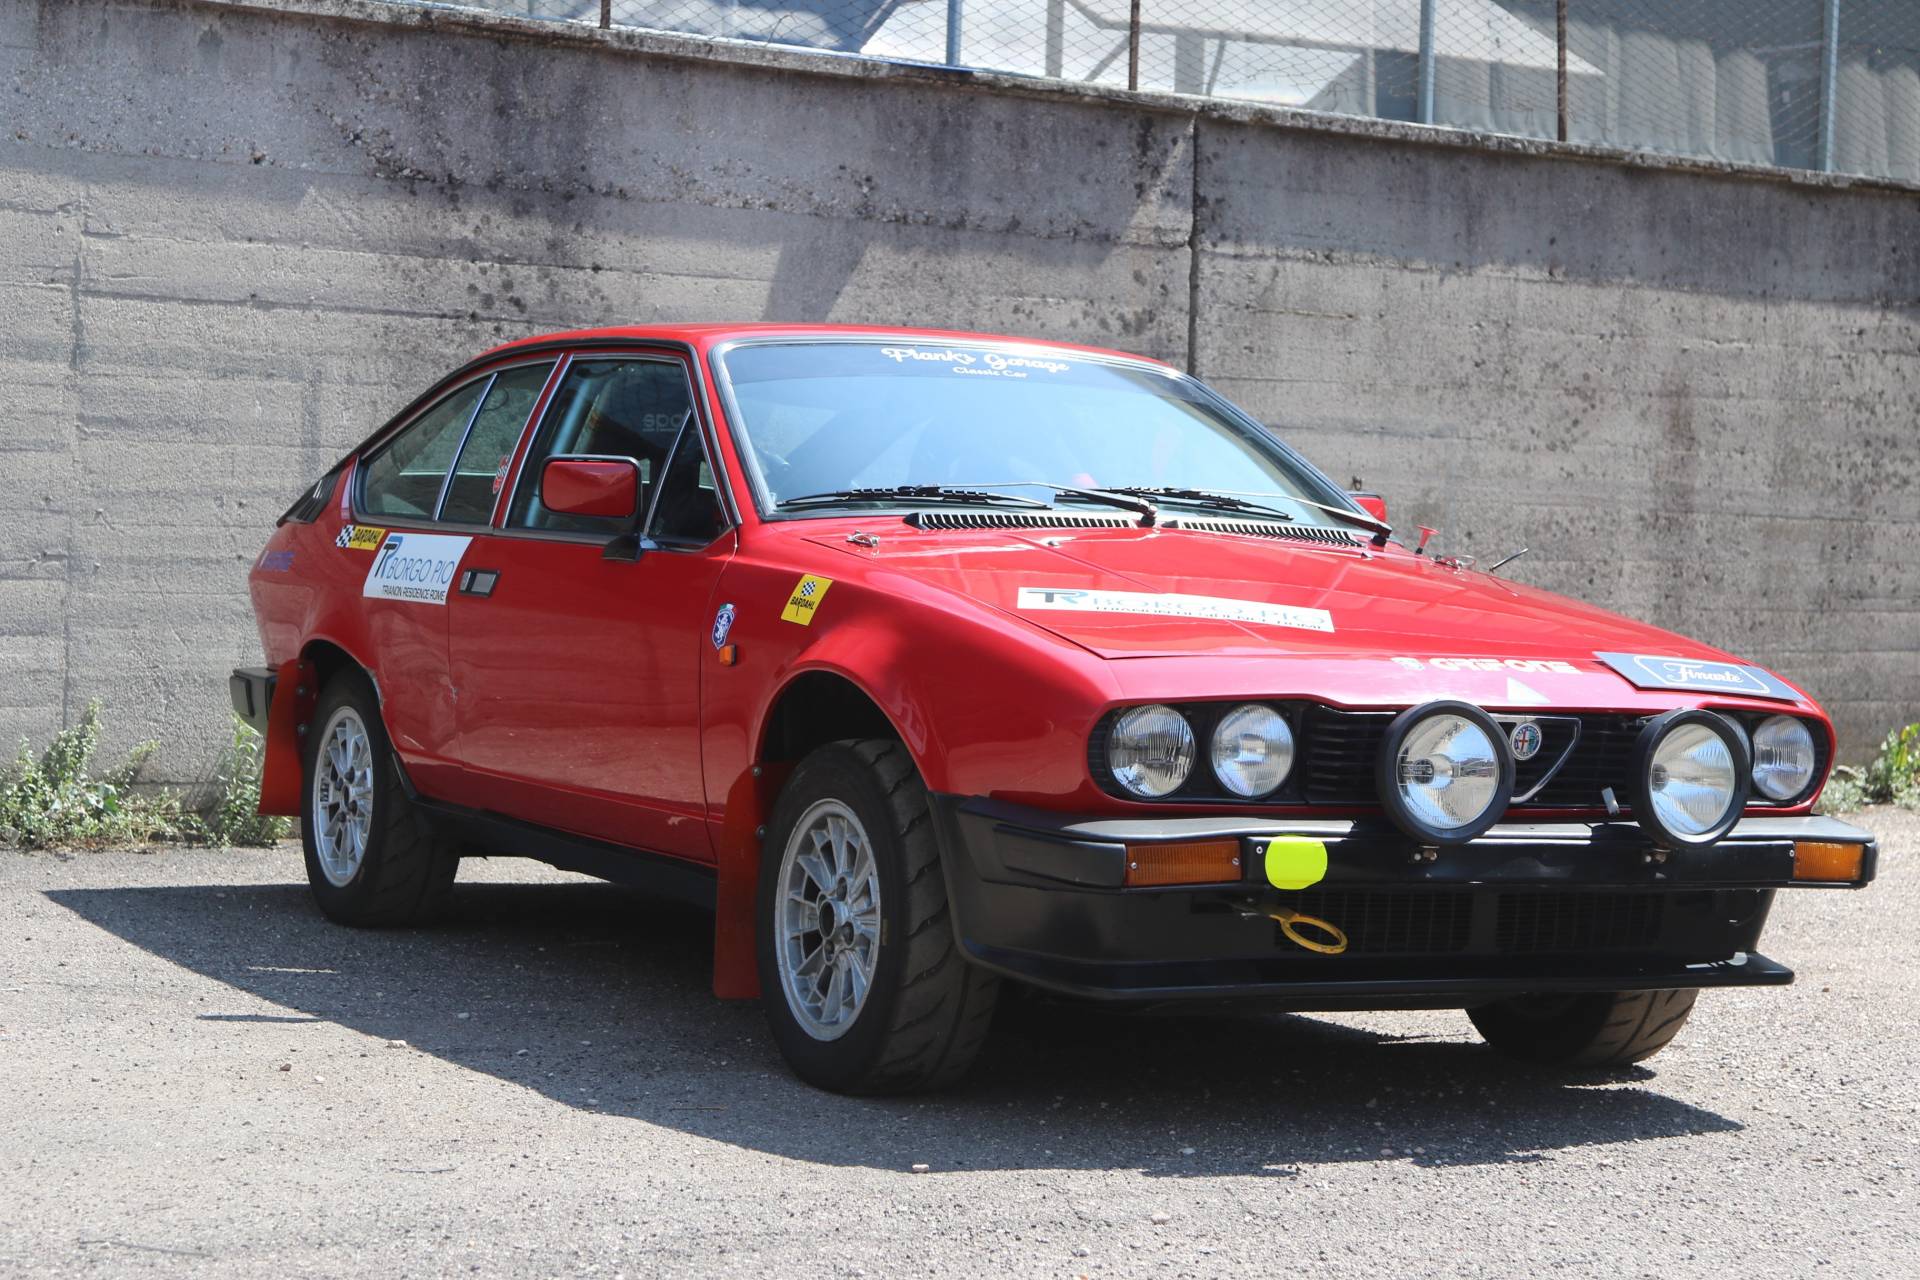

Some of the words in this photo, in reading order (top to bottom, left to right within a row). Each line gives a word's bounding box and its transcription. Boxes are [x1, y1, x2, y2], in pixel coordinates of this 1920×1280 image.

[953, 366, 1000, 376] Classic
[1002, 369, 1028, 379] Car
[984, 353, 1070, 373] Garage
[352, 527, 382, 546] BARDAHL
[387, 557, 432, 583] BORGO
[430, 560, 455, 585] PIO
[402, 587, 431, 600] RESIDENCE
[430, 589, 446, 601] ROME
[790, 596, 816, 611] BARDAHL
[1663, 662, 1745, 684] Finarte
